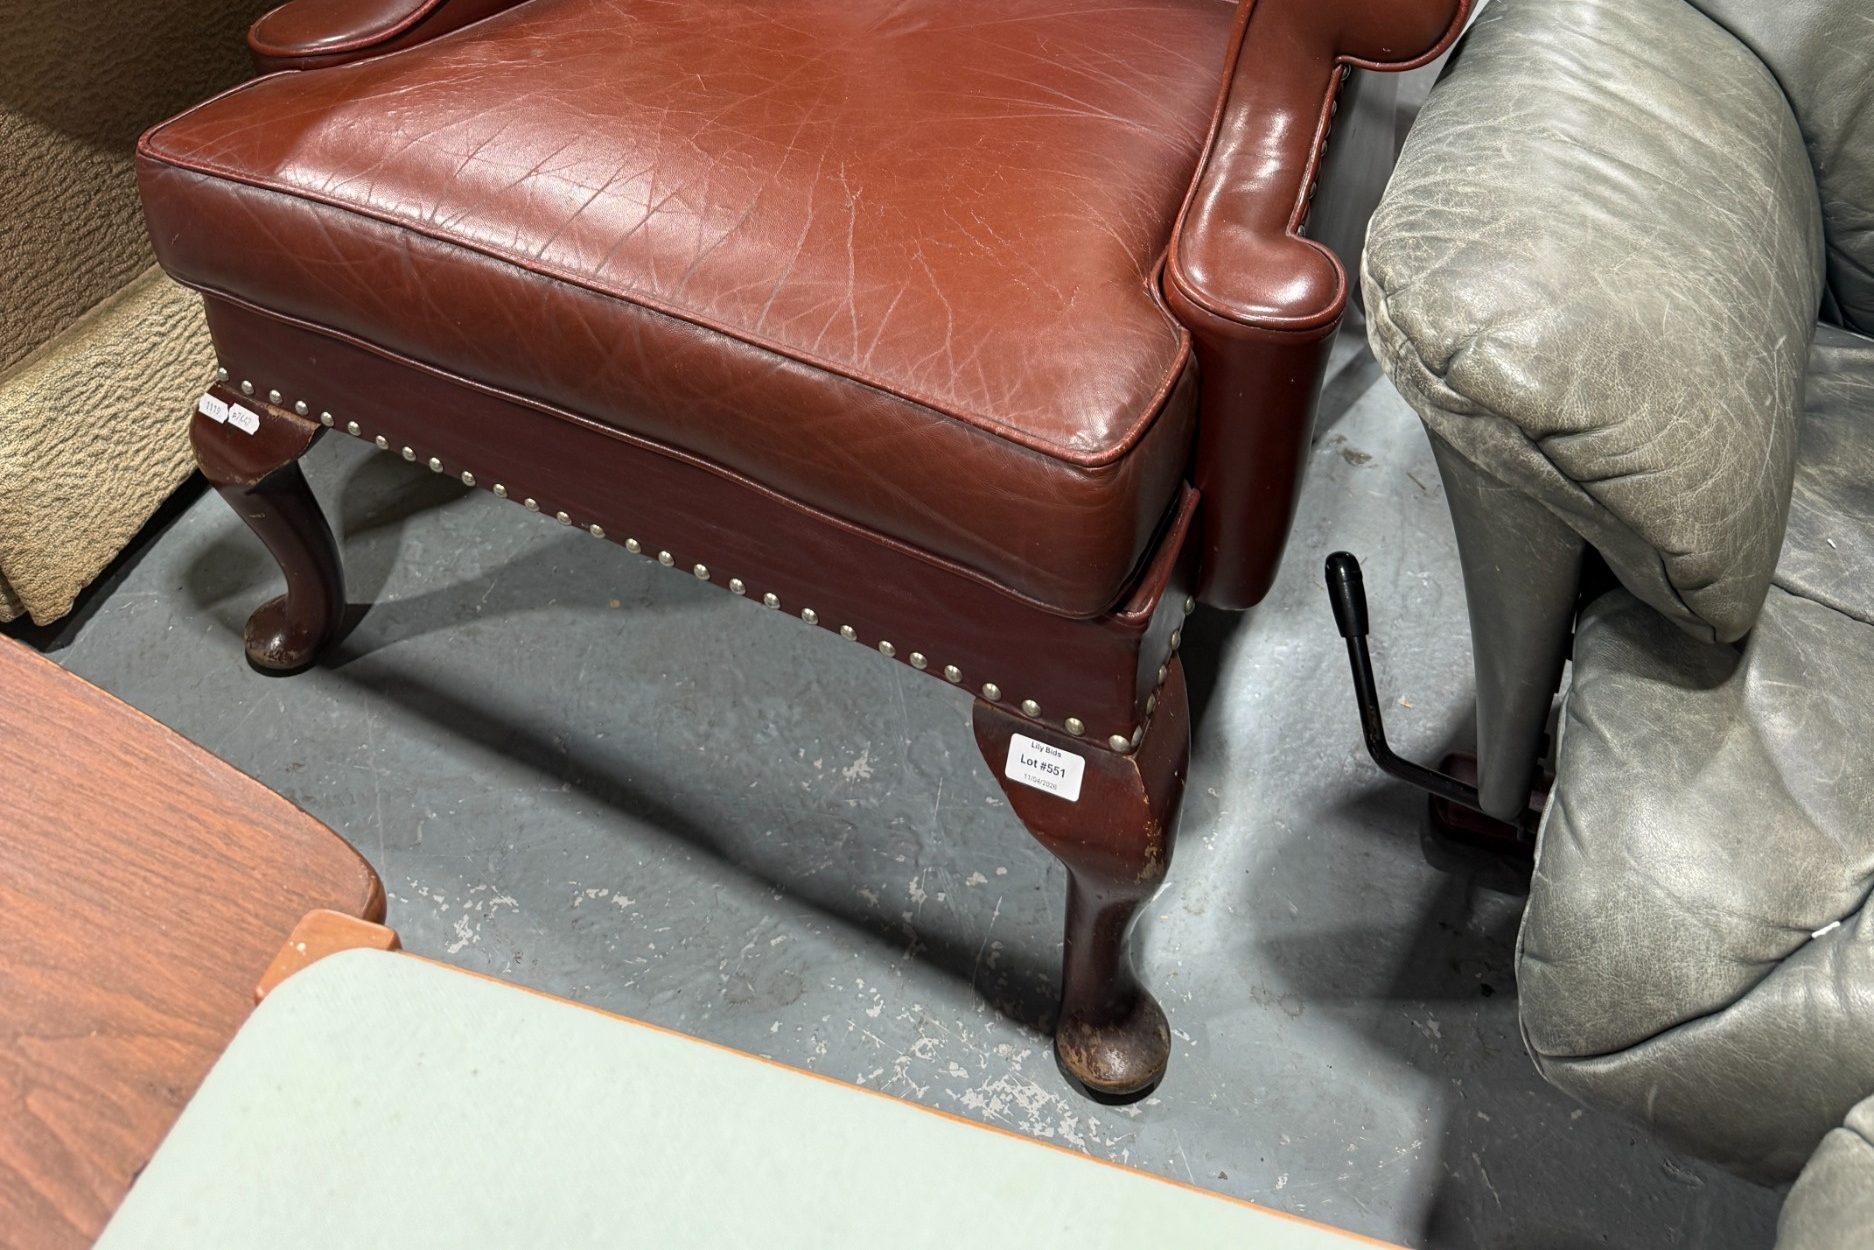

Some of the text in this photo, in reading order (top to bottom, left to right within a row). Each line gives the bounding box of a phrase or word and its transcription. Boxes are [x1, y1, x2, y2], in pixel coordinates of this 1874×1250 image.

[1031, 741, 1062, 758] Lily Bids
[1020, 753, 1066, 778] Lot #551
